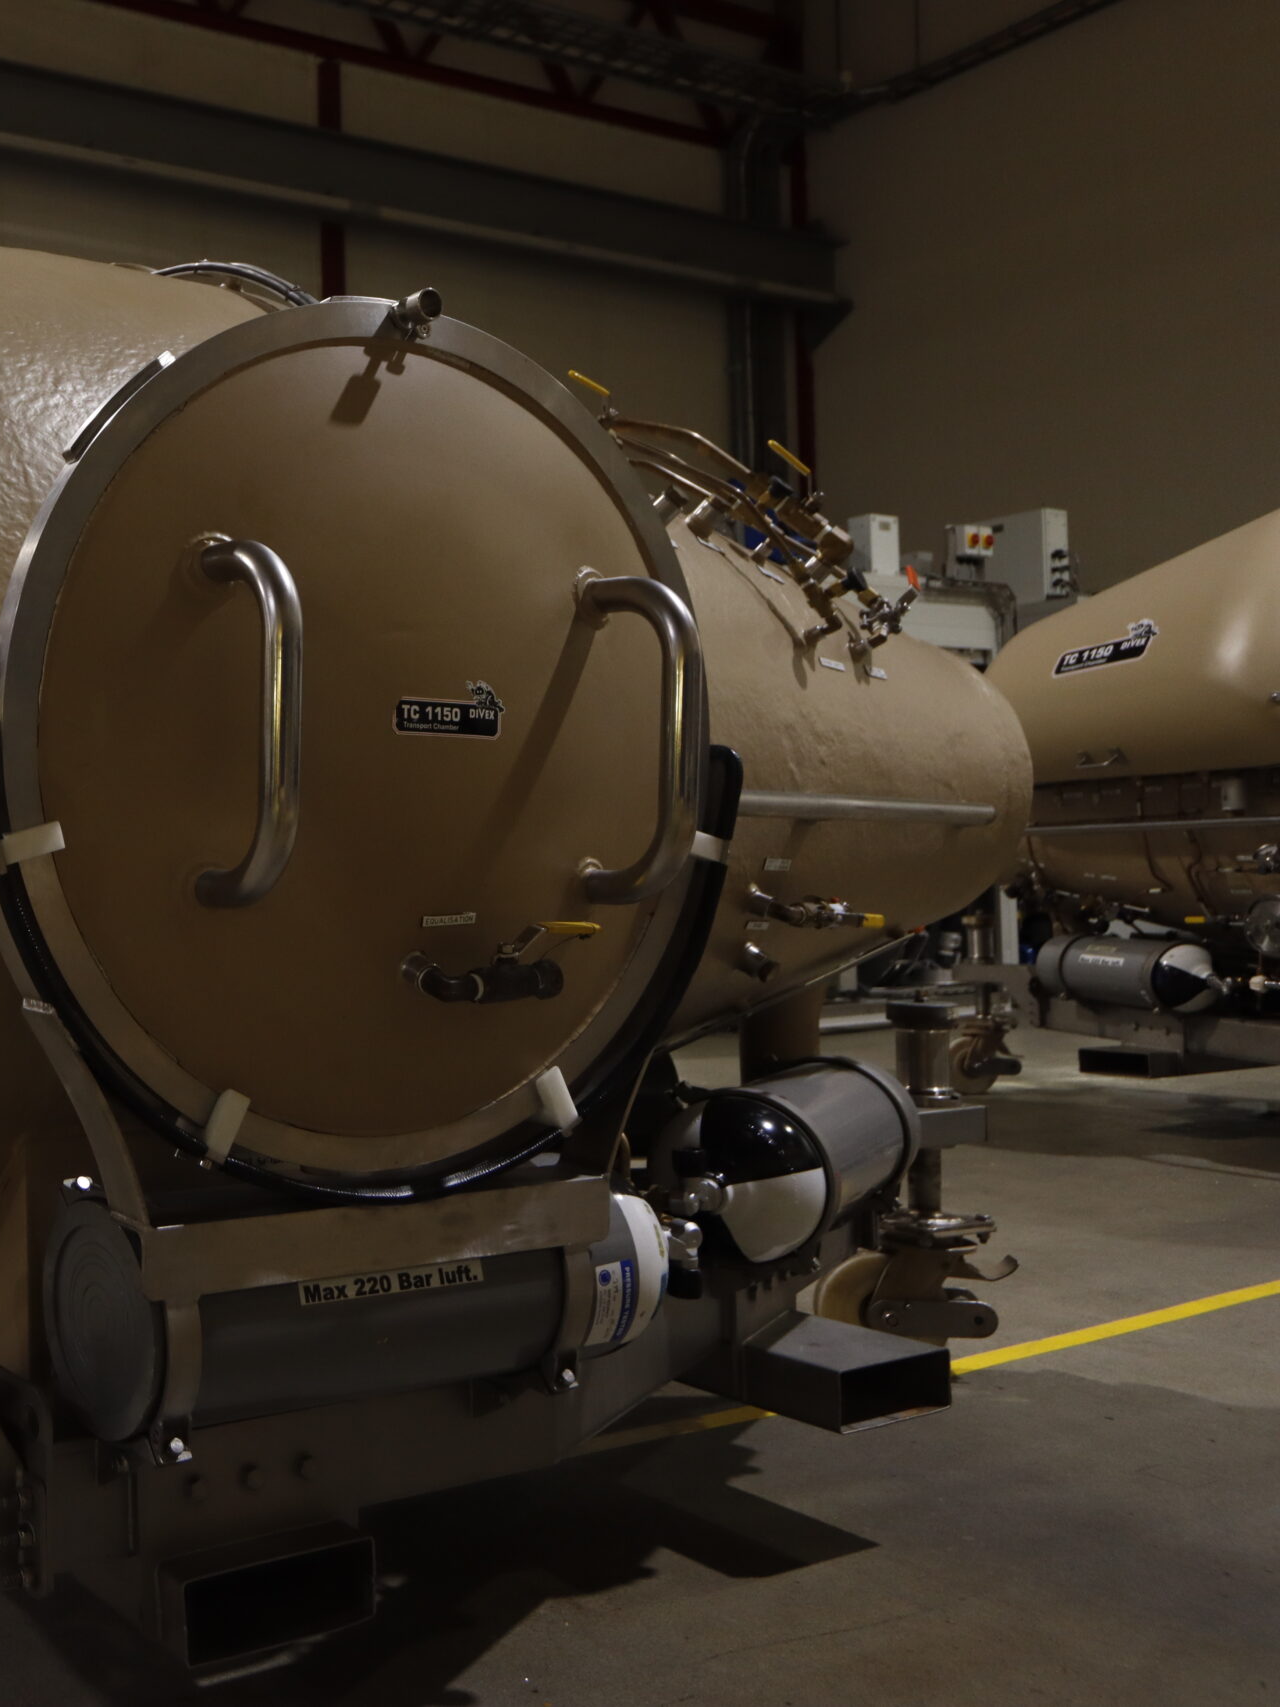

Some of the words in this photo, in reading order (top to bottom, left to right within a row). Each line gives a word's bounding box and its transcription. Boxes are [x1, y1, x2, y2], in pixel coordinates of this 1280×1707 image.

[1063, 653, 1079, 666] TC
[1082, 645, 1114, 662] 1150
[401, 704, 420, 719] TC
[425, 706, 461, 721] 1150
[469, 709, 495, 720] DIVEX
[403, 721, 433, 730] Transport
[433, 723, 460, 731] Chamber
[303, 1285, 348, 1303] Max
[354, 1275, 391, 1296] 220
[398, 1272, 432, 1290] Bar
[438, 1265, 478, 1285] luft.
